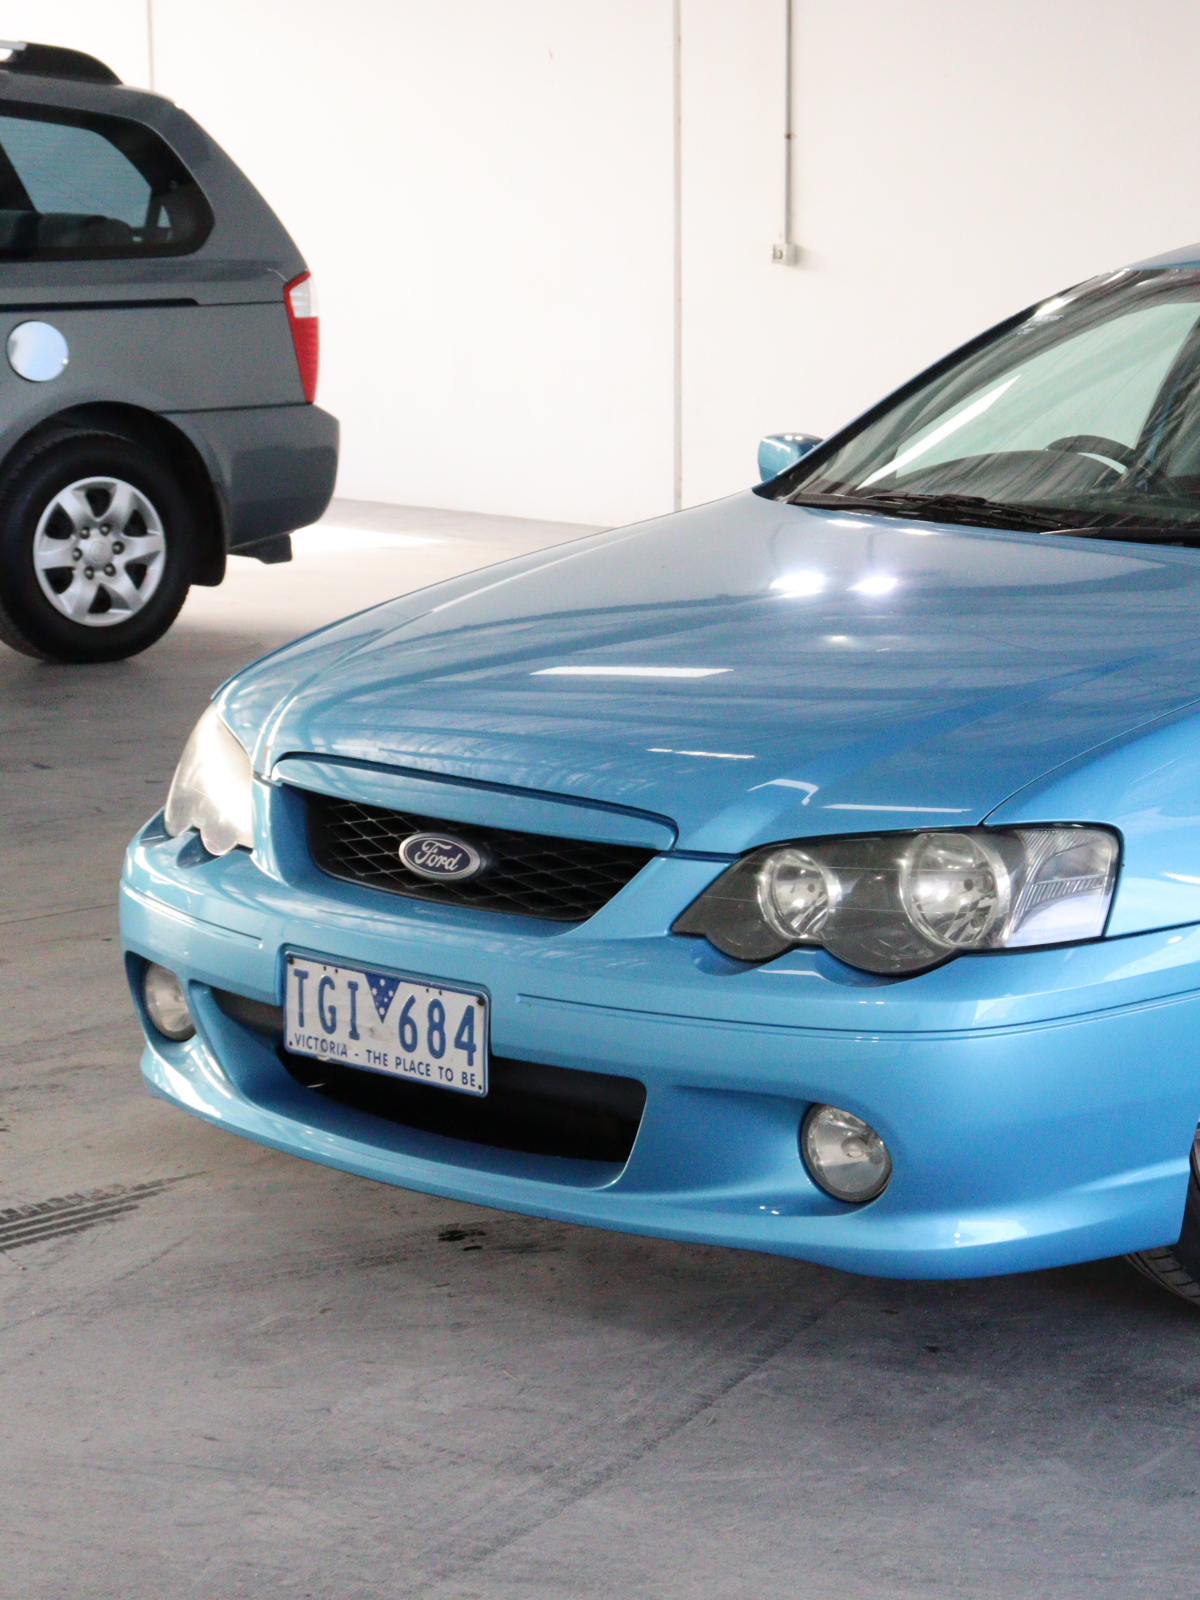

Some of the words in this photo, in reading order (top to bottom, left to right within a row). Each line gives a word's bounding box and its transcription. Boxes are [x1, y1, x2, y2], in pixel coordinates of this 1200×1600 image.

[414, 840, 462, 871] Ford
[294, 968, 360, 1041] TGI
[399, 994, 477, 1067] 684
[294, 1033, 348, 1058] VICTORIA
[366, 1049, 389, 1067] THE
[395, 1056, 431, 1077] PLACE
[438, 1066, 454, 1083] TO
[462, 1071, 476, 1087] BE
